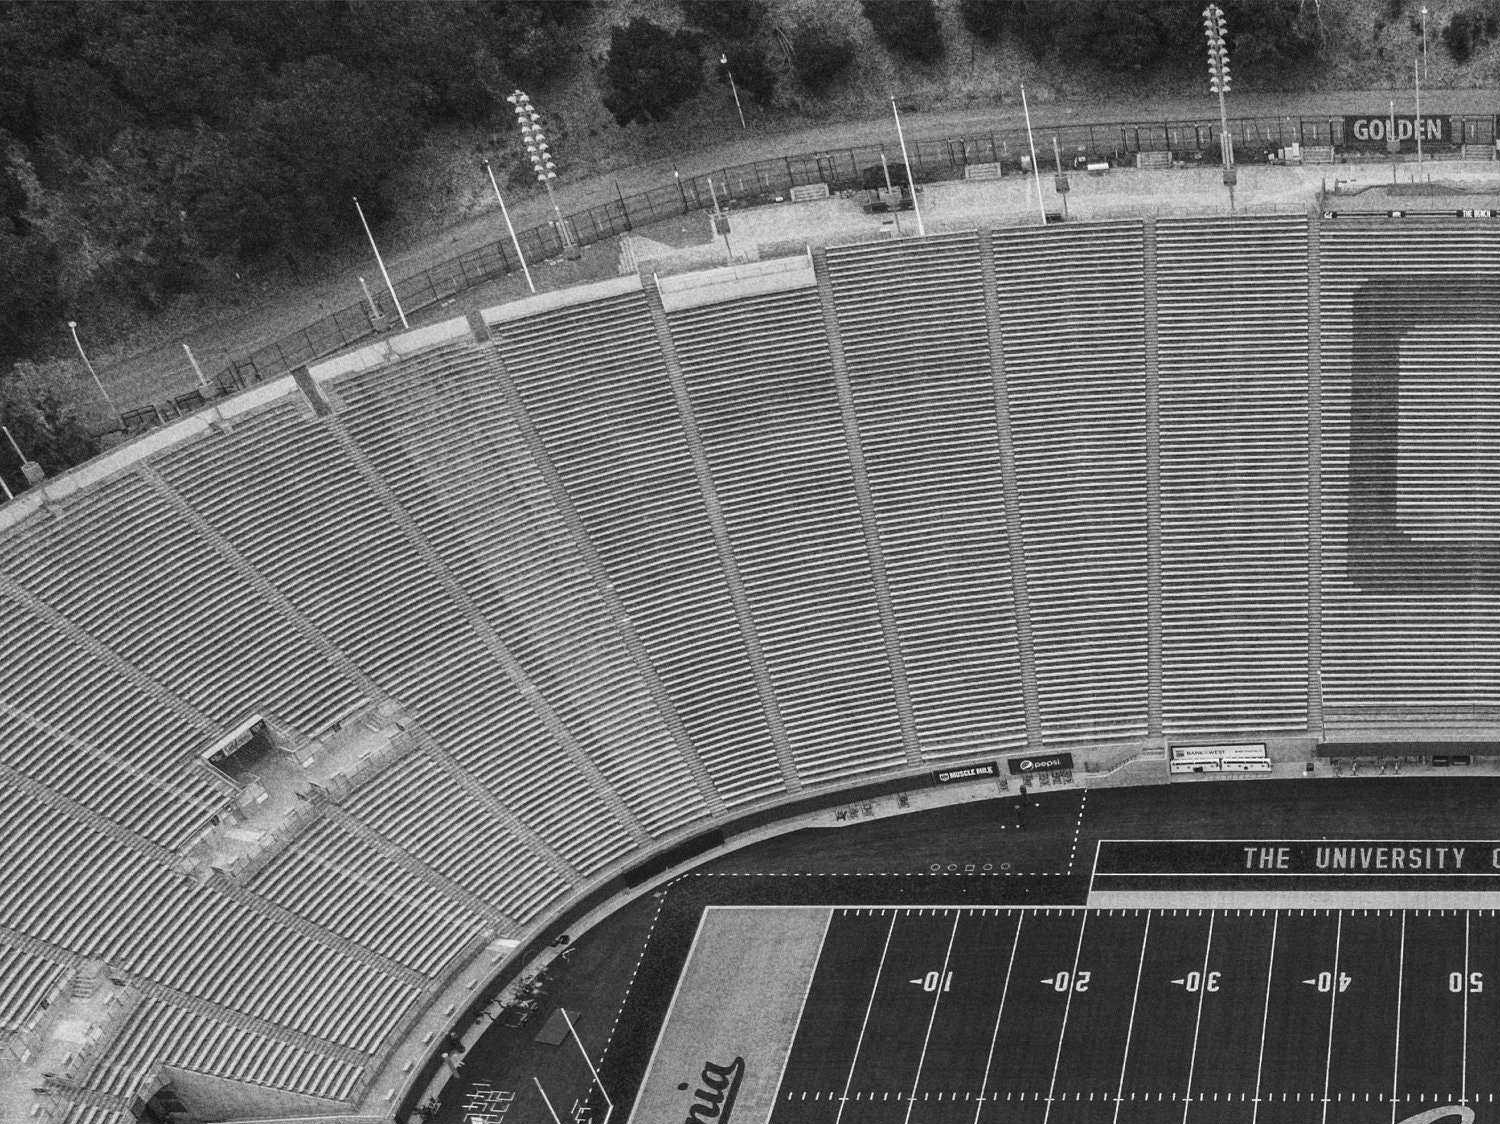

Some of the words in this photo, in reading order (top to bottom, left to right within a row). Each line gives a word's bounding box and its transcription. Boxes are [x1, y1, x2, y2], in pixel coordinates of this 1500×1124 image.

[1353, 119, 1442, 140] GOLDEN
[949, 769, 976, 779] MUSCLE
[976, 766, 994, 775] MILK
[1034, 758, 1061, 768] pepsi
[1243, 847, 1290, 869] THE
[1315, 847, 1465, 869] UNIVERSITY
[924, 971, 953, 992] 10
[1055, 971, 1091, 992] 20
[1185, 971, 1221, 992] 30
[1317, 971, 1352, 992] 40
[1449, 971, 1483, 992] 50
